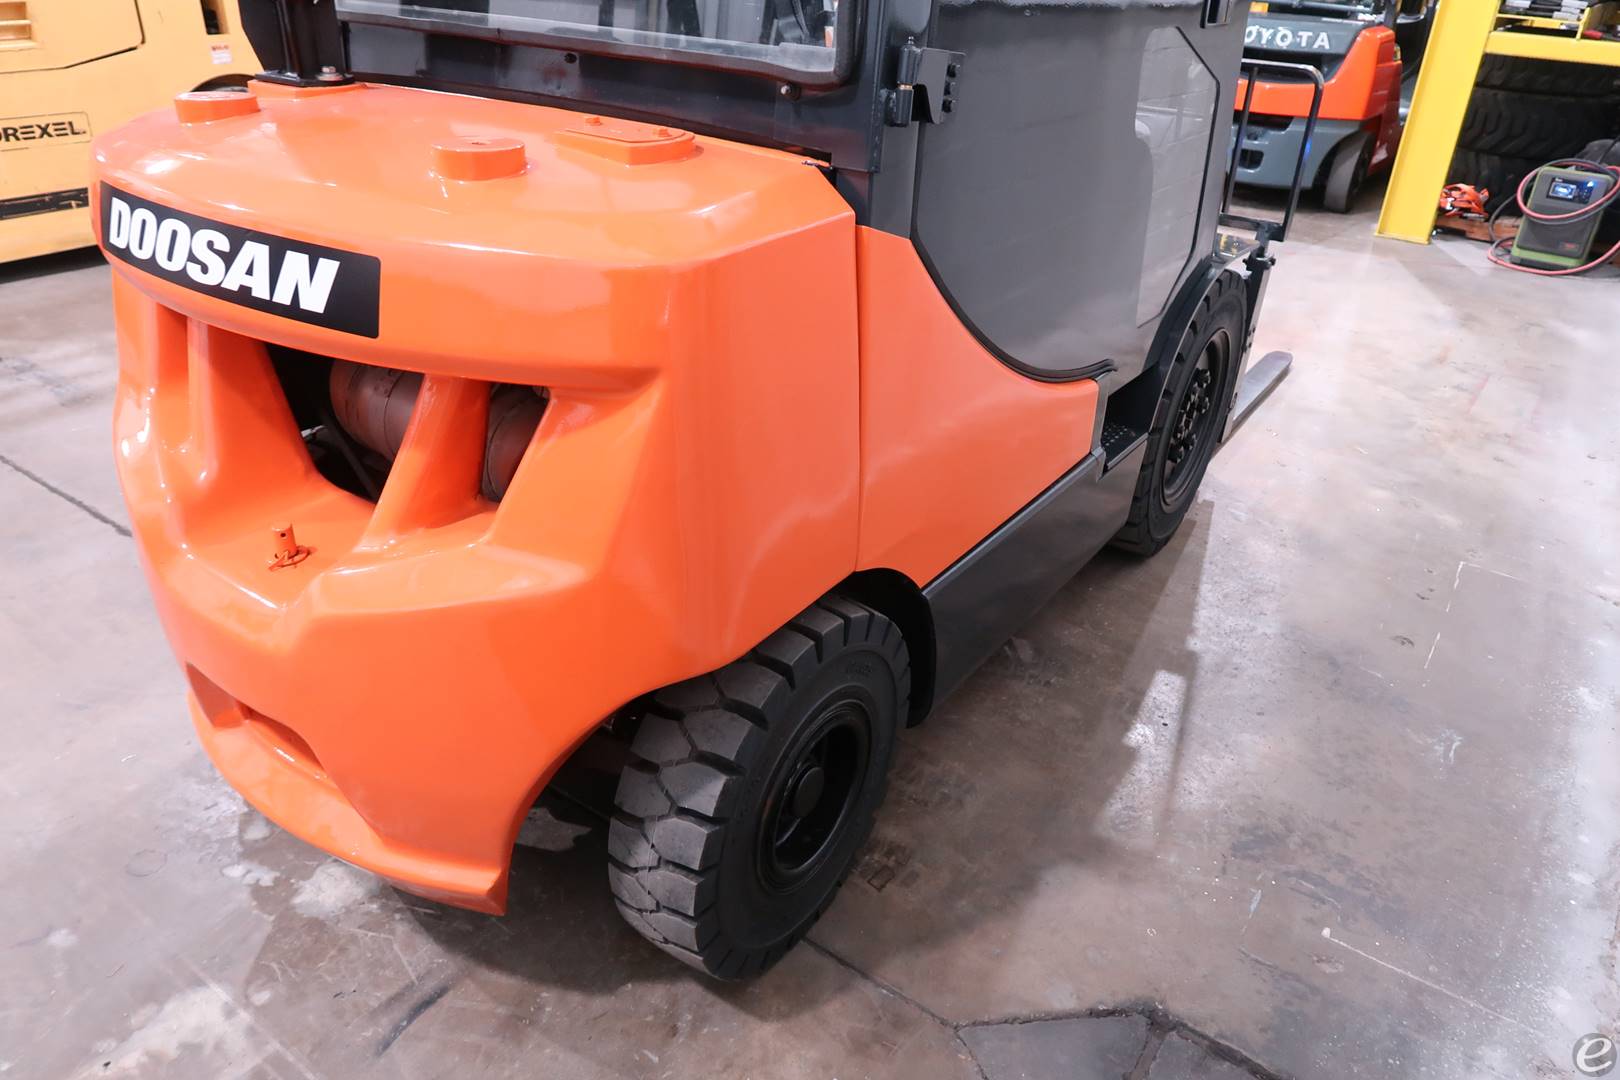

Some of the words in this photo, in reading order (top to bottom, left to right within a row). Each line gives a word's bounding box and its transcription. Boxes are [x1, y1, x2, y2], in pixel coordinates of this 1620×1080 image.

[1244, 25, 1330, 50] OYOTA
[0, 121, 83, 142] REXEL
[109, 196, 341, 314] DOOSAN
